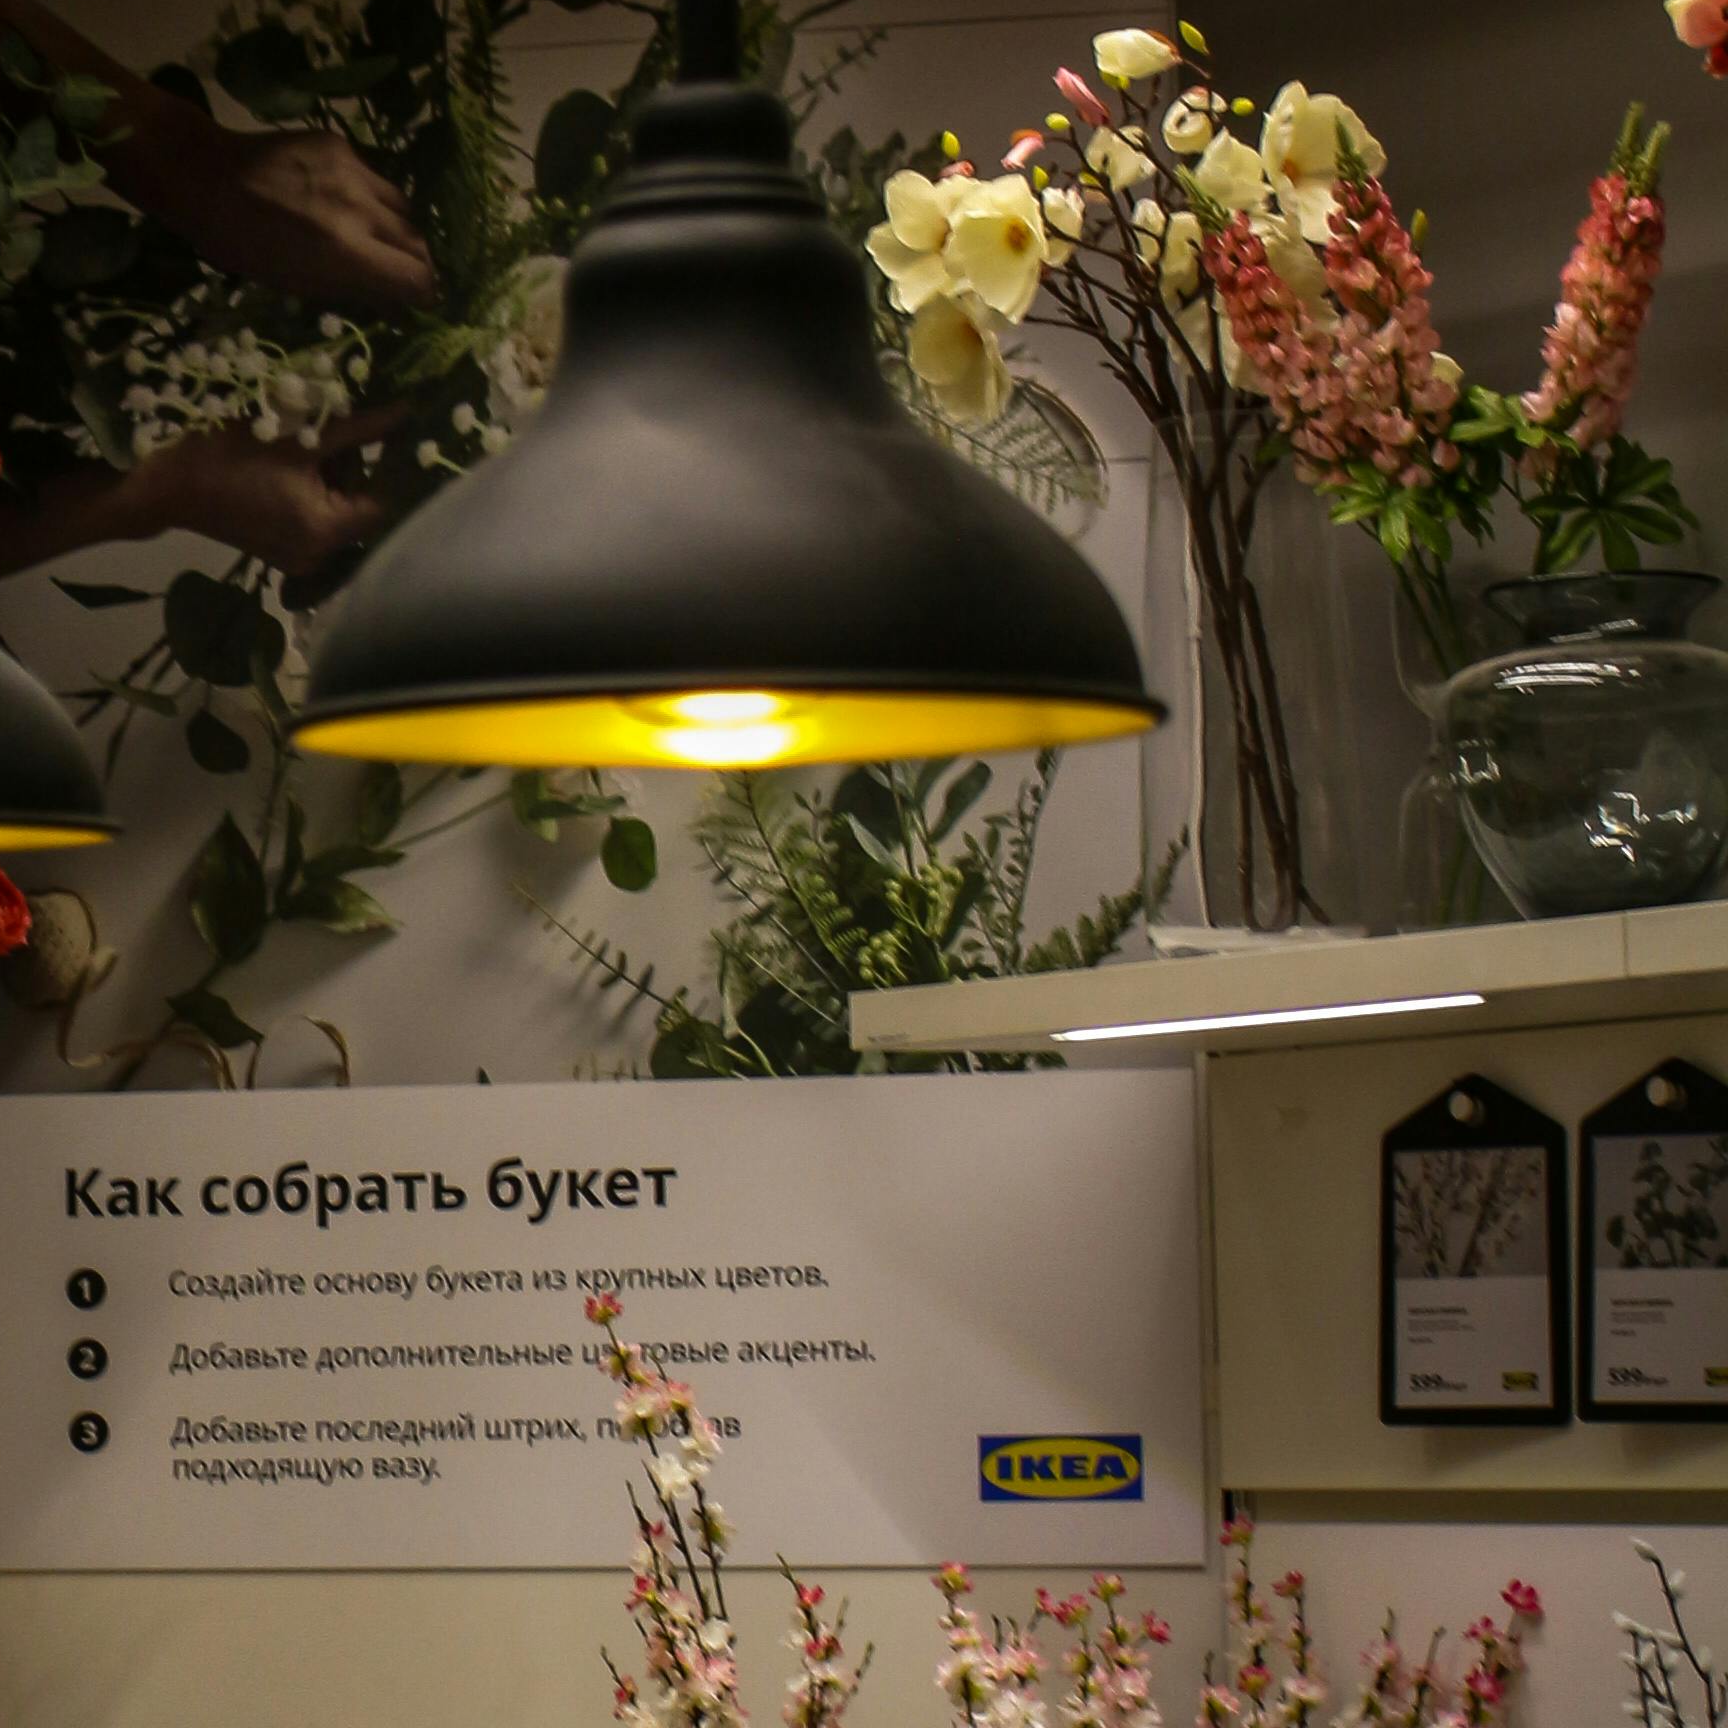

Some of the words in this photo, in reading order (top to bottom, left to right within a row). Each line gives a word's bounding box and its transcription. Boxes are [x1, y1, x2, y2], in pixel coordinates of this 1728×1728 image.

[66, 1167, 183, 1217] Как
[200, 1160, 467, 1229] собрать
[486, 1157, 677, 1224] букет
[168, 1267, 306, 1301] Создайте
[313, 1270, 418, 1300] основу
[426, 1265, 523, 1300] букета
[531, 1270, 567, 1290] из
[575, 1266, 706, 1295] крупных
[714, 1265, 830, 1293] цветов.
[169, 1342, 308, 1376] Добавьте
[315, 1343, 573, 1374] дополнительные
[582, 1341, 729, 1366] цтовые
[738, 1338, 876, 1368] акценты.
[170, 1415, 308, 1449] Добавьте
[315, 1411, 476, 1447] последний
[484, 1418, 588, 1447] штрих,
[597, 1416, 742, 1441] побав
[173, 1456, 364, 1487] подходящую
[372, 1456, 442, 1486] вазу.
[996, 1454, 1129, 1481] IKEA
